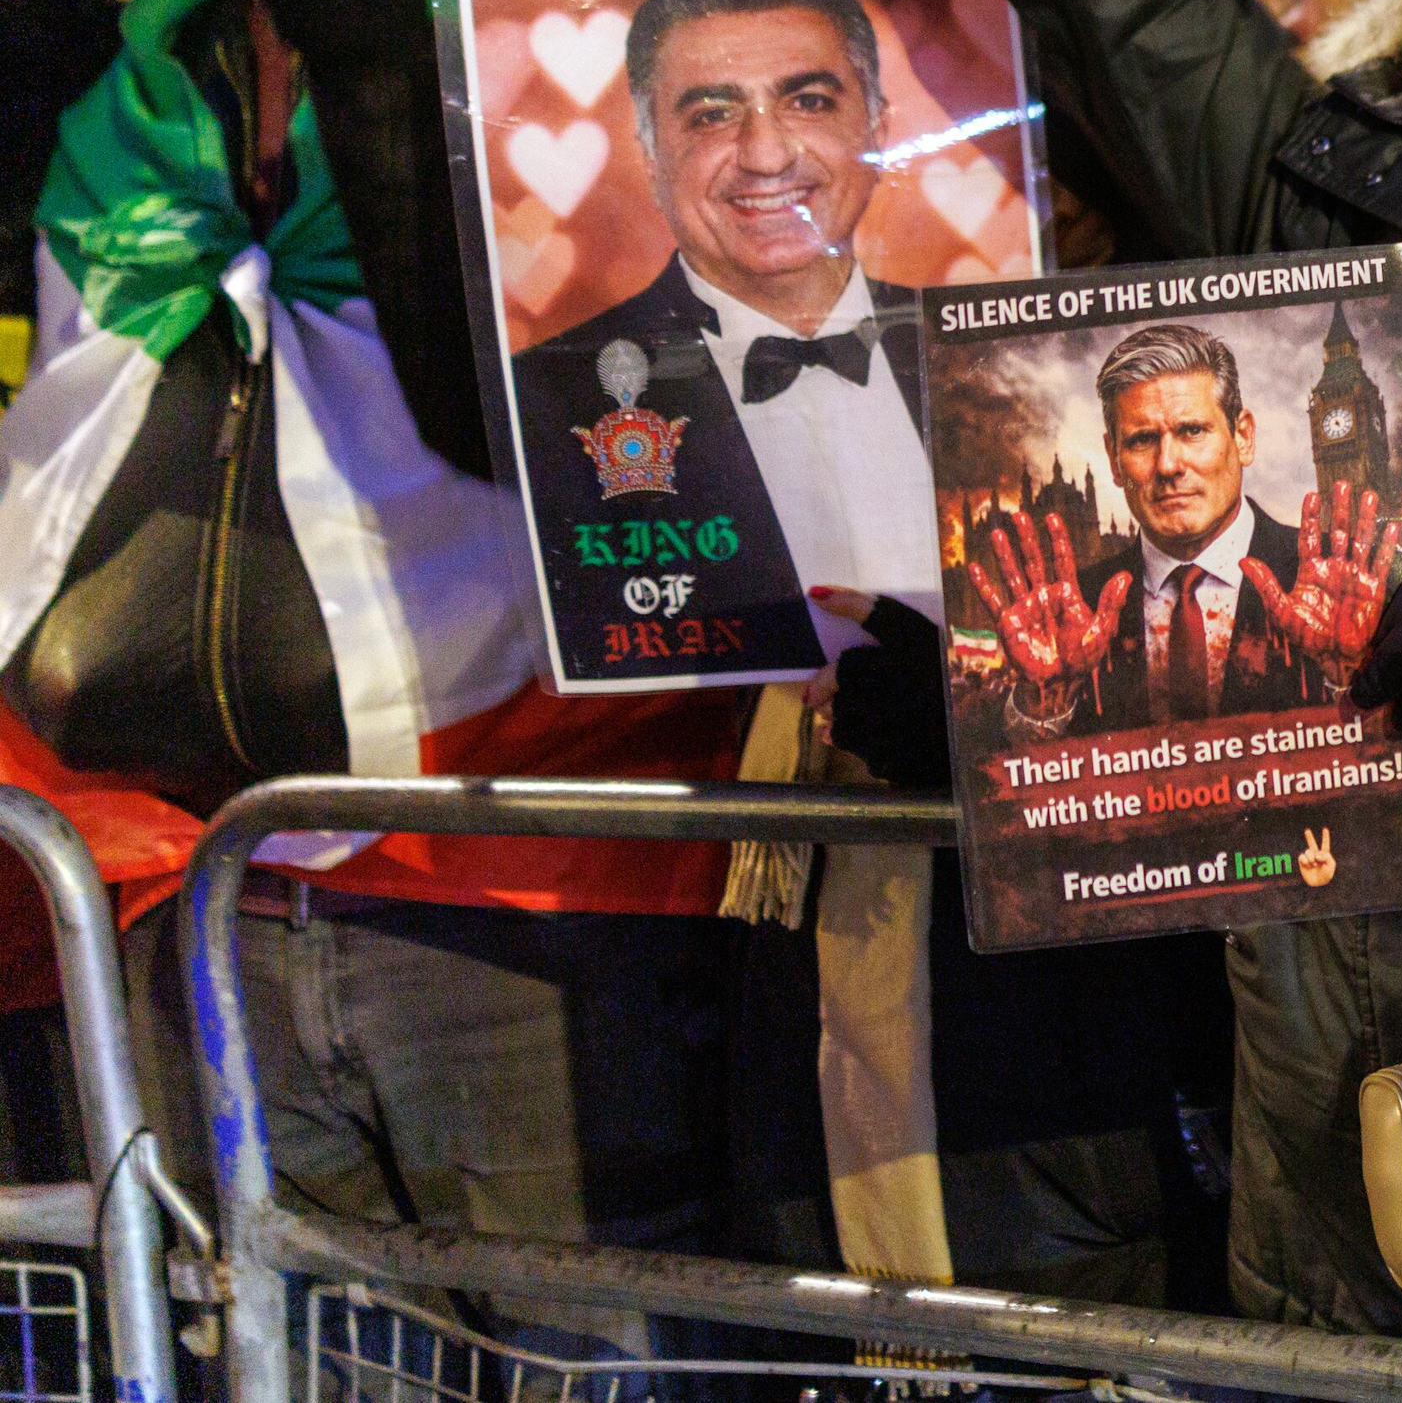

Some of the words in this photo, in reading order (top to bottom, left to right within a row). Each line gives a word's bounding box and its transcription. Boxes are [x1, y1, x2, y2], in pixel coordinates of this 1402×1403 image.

[940, 294, 1053, 333] SILENCE
[1057, 288, 1096, 318] OF
[1098, 282, 1154, 315] THE
[1157, 276, 1199, 305] UK
[1200, 257, 1387, 302] GOVERNMENT
[574, 515, 739, 567] KING
[623, 574, 697, 619] OF
[603, 619, 743, 663] IRAN
[1003, 751, 1084, 788] Their
[1090, 738, 1188, 777] hands
[1193, 735, 1244, 764] are
[1249, 715, 1364, 757] stained
[1023, 798, 1089, 830] with
[1092, 790, 1142, 820] the
[1146, 776, 1231, 814] blood
[1235, 766, 1270, 802] of
[1063, 862, 1192, 901] Freedom
[1196, 852, 1228, 882] of
[1234, 851, 1294, 880] Iran
